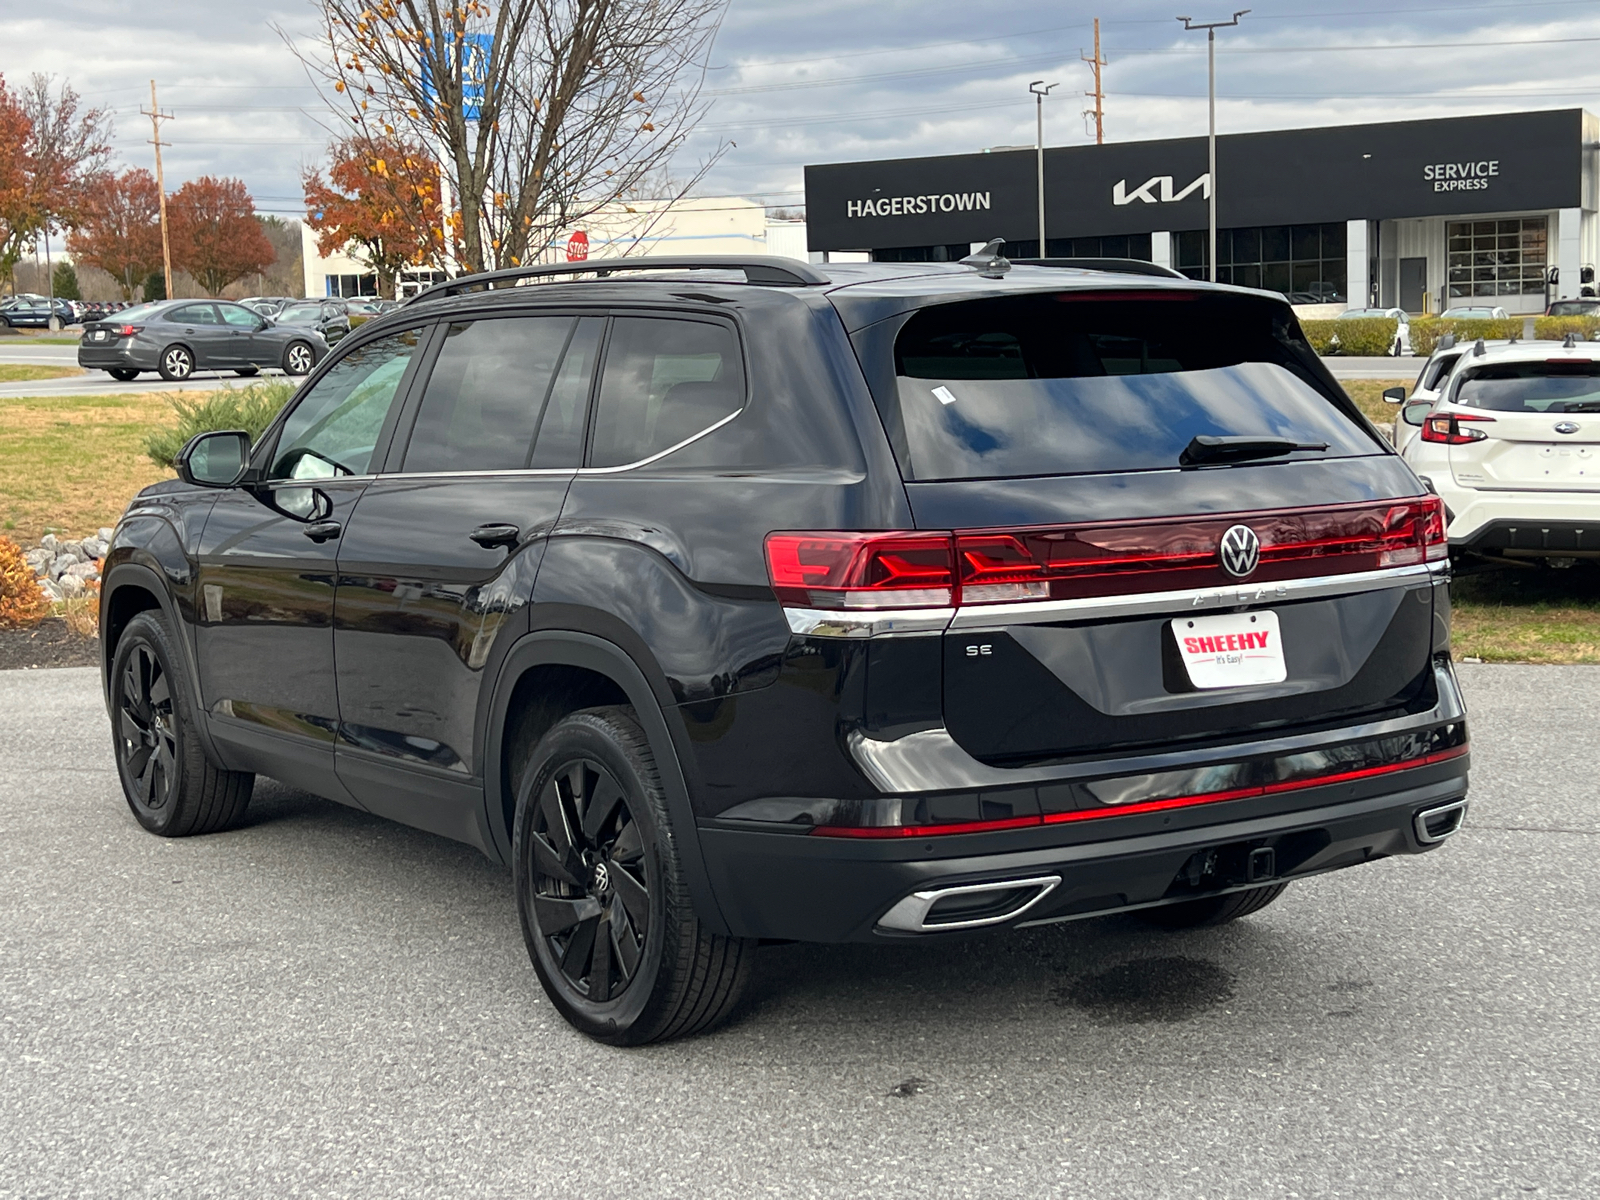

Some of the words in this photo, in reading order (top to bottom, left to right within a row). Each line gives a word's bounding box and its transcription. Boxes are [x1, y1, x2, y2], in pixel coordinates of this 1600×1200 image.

[1424, 160, 1499, 180] SERVICE
[1434, 178, 1488, 192] EXPRESS
[847, 191, 991, 217] HAGERSTOWN
[1192, 586, 1287, 606] ATLAS
[966, 645, 992, 656] SE
[1184, 631, 1269, 654] SHEEHY
[1215, 655, 1225, 665] It's
[1226, 653, 1243, 666] Easy!
